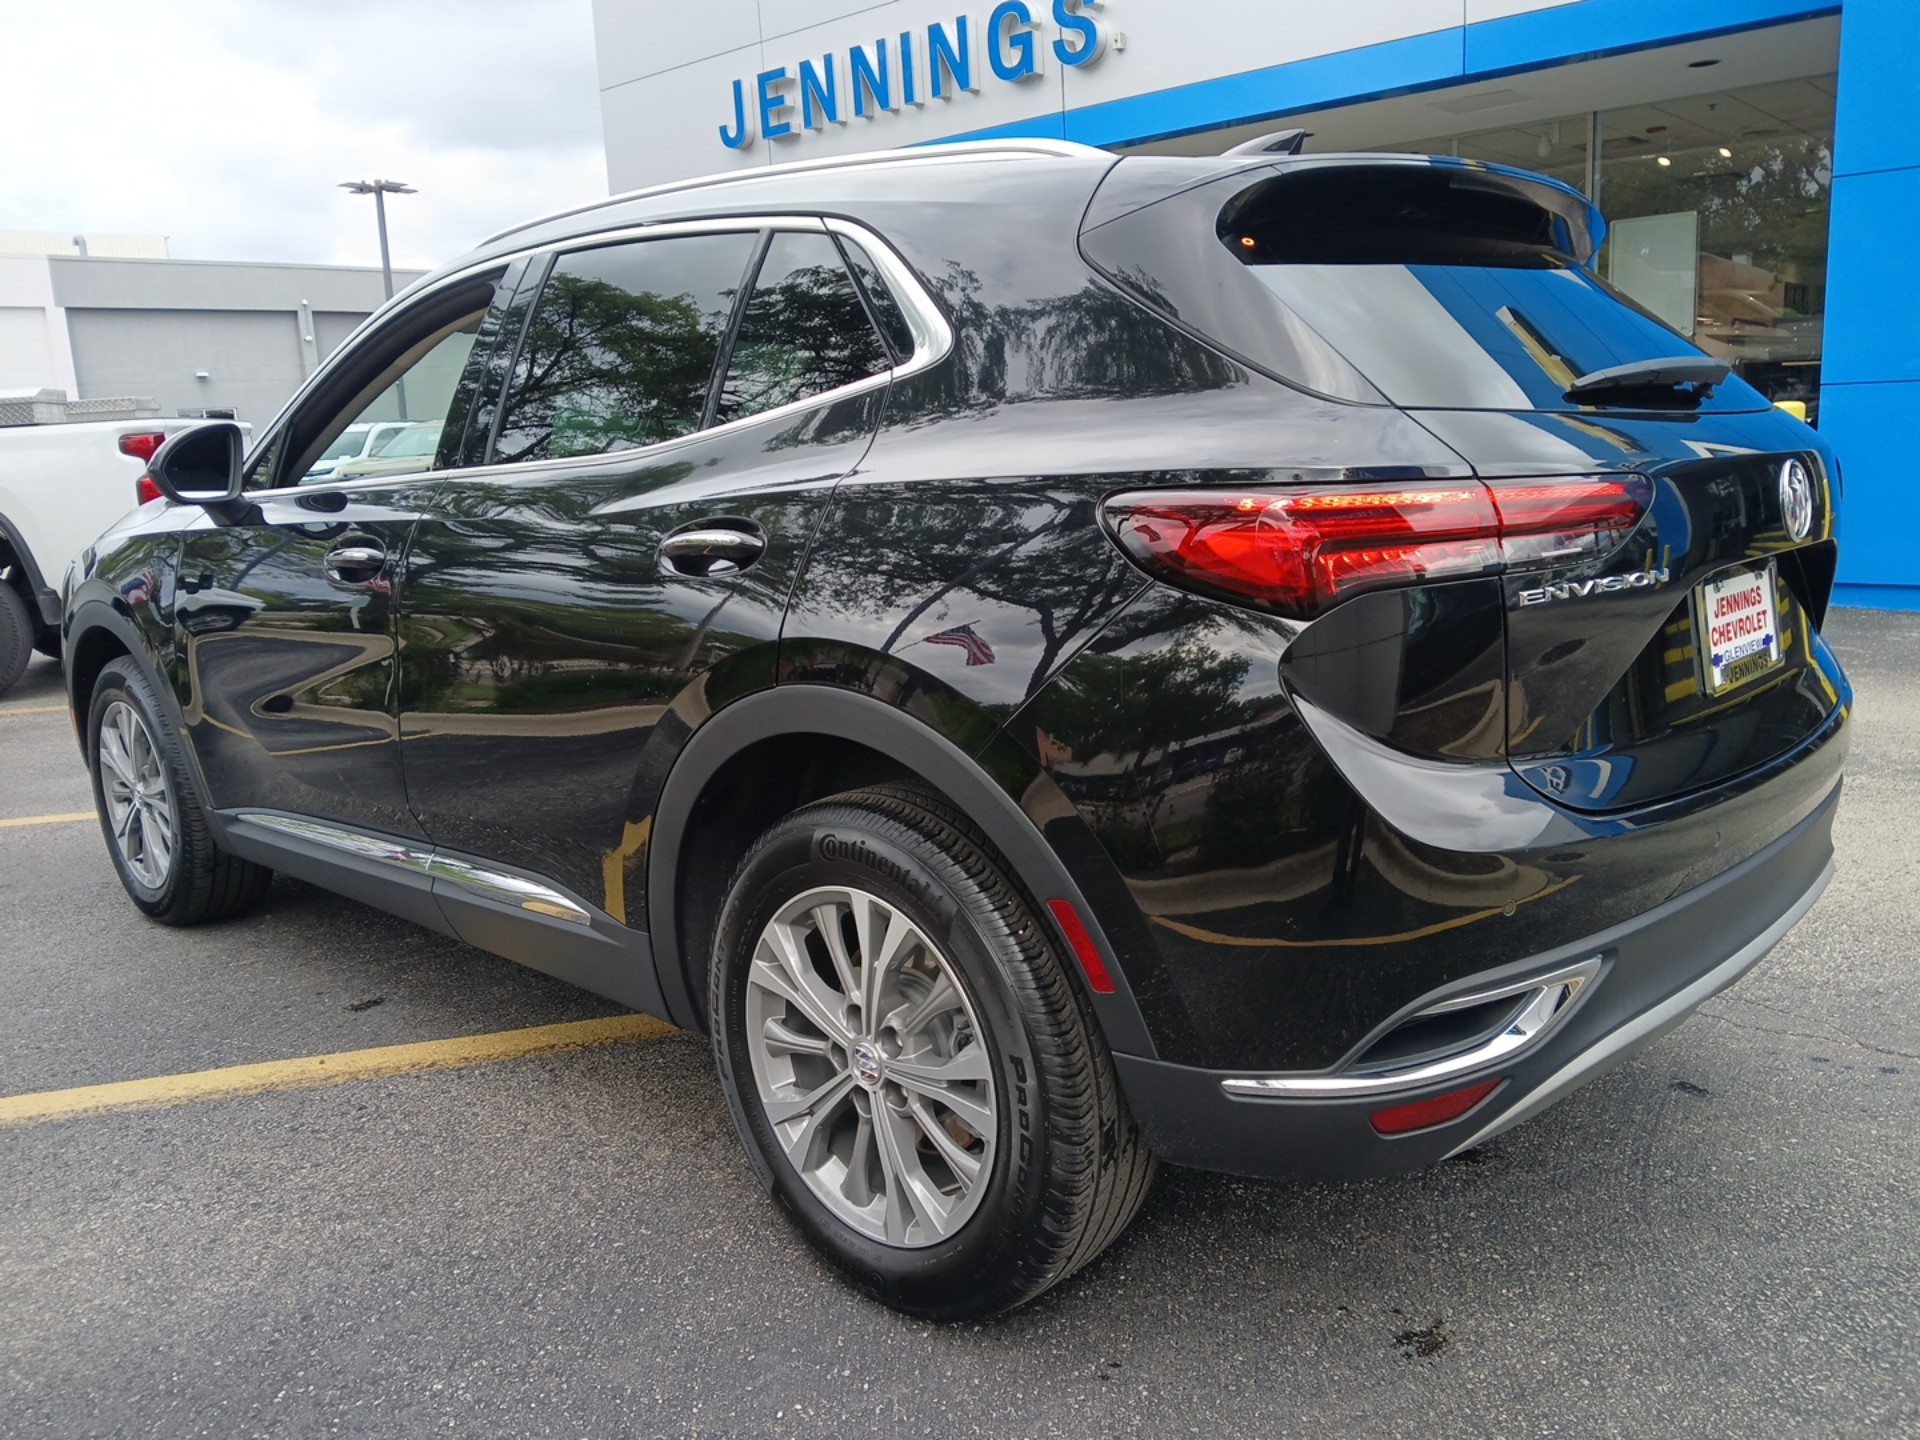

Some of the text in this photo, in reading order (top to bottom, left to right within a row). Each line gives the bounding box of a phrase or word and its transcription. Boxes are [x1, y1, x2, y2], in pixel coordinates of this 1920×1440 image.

[719, 0, 1103, 149] JENNINGS
[1519, 568, 1670, 608] ENVISION
[1714, 585, 1762, 619] JENNINGS
[1711, 609, 1768, 647] CHEVROLET
[1723, 638, 1764, 662] GLENVIEW
[1728, 655, 1768, 684] JENNINGS
[819, 832, 931, 899] Continental
